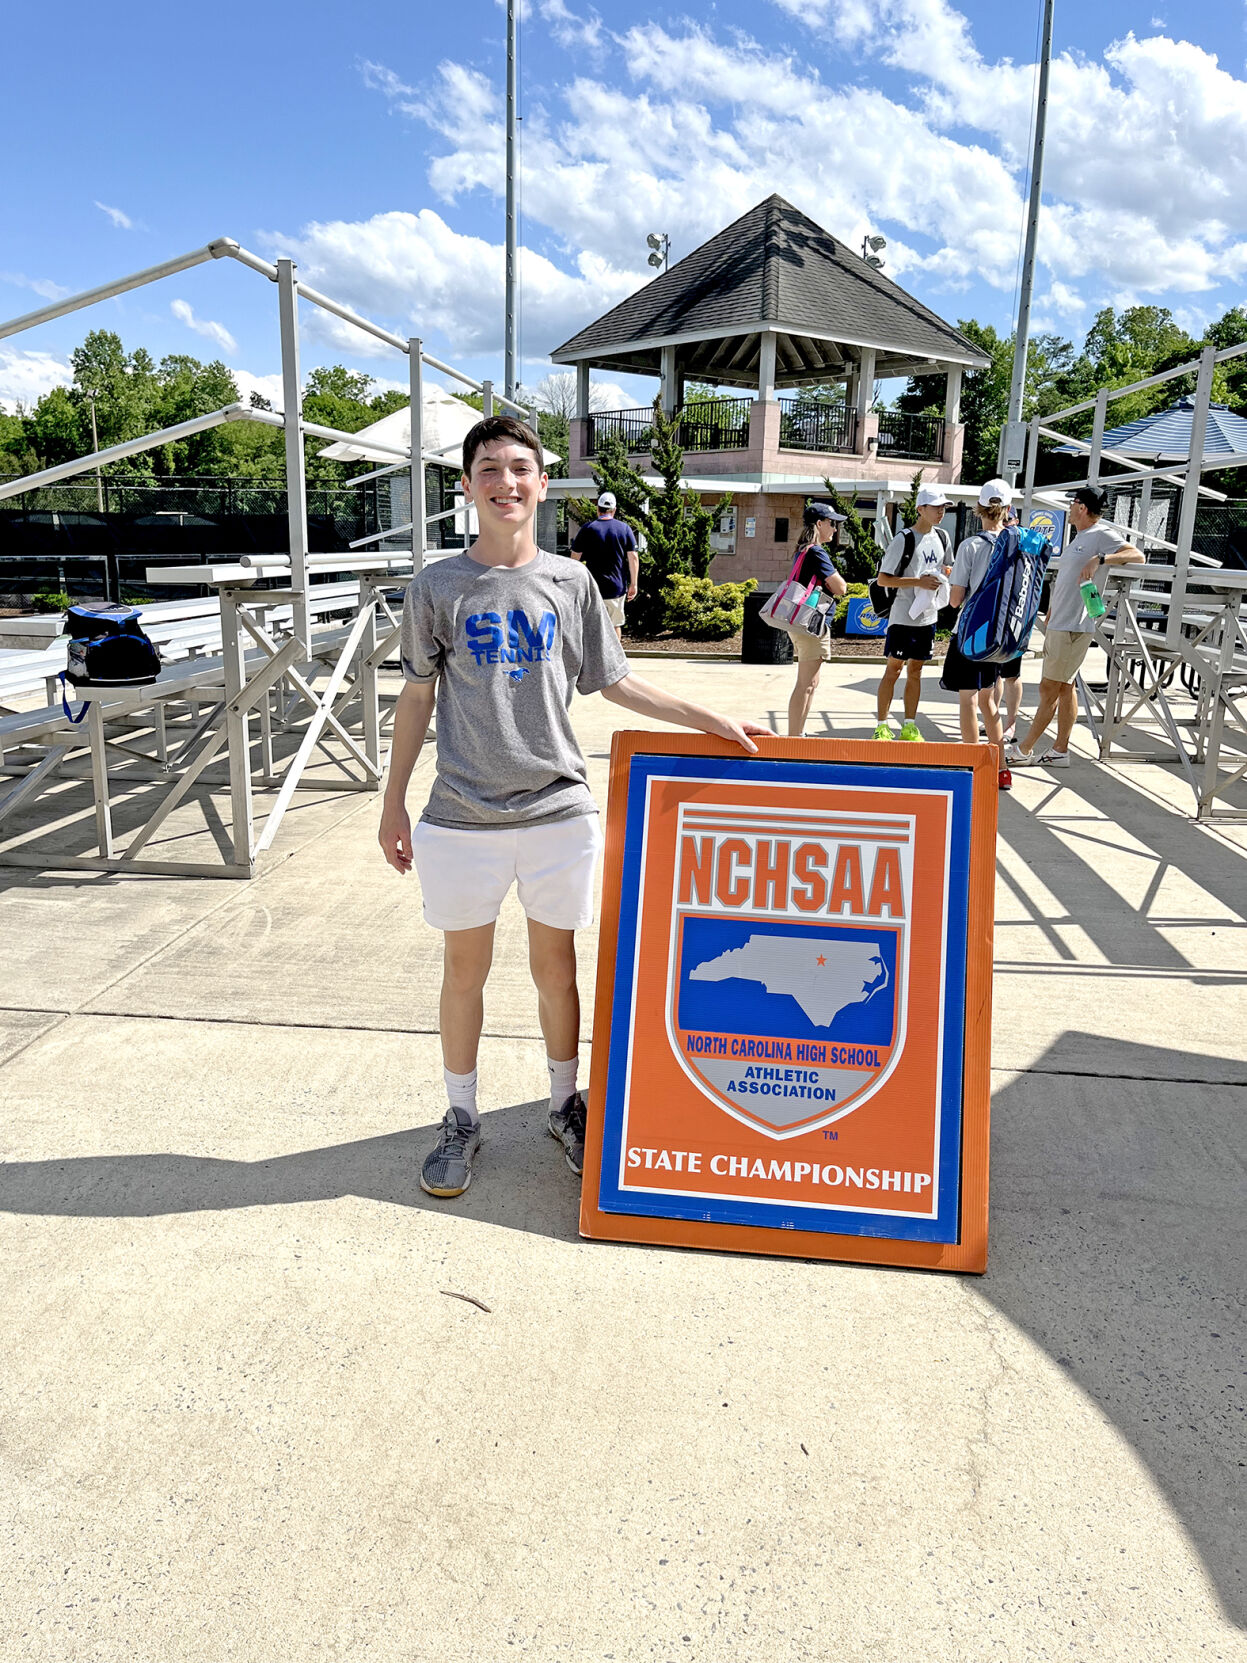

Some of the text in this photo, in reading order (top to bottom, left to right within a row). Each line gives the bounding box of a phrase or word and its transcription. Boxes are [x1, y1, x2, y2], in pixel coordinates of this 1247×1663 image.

[922, 549, 937, 565] WA
[1014, 557, 1031, 619] Babolat
[465, 609, 557, 651] SM
[676, 834, 906, 919] NCHSAA
[687, 1034, 881, 1068] NORTH CAROLINA HIGH SCHOOL
[727, 1080, 836, 1101] ASSOCIATION
[744, 1066, 819, 1084] ATHLETIC
[822, 1130, 839, 1141] TM
[627, 1146, 932, 1194] STATE CHAMPIONSHIP
